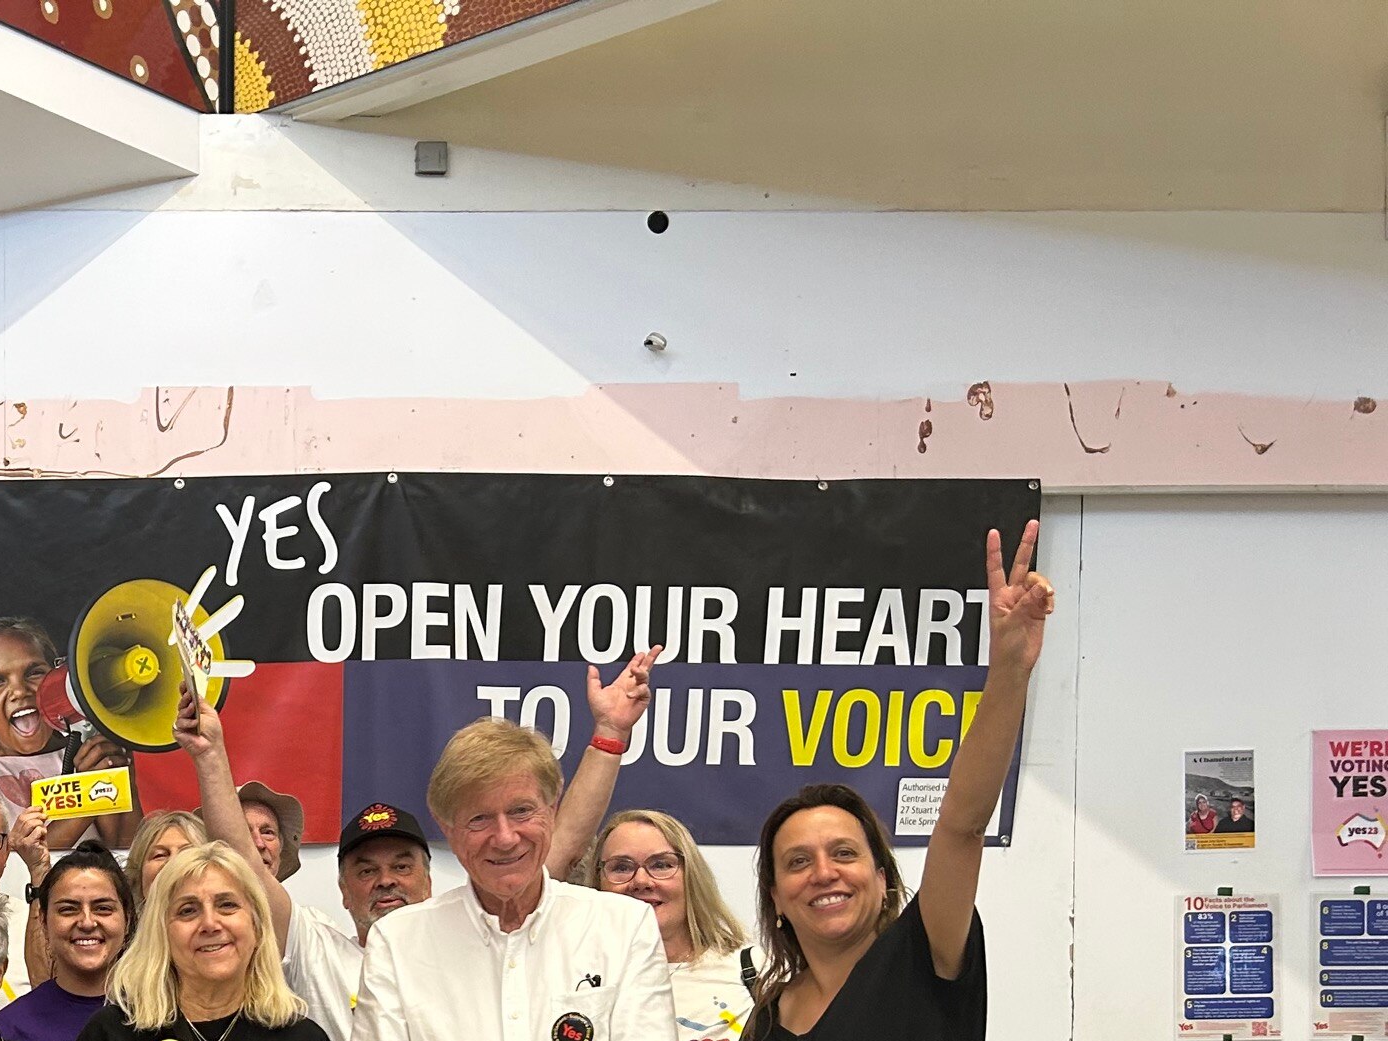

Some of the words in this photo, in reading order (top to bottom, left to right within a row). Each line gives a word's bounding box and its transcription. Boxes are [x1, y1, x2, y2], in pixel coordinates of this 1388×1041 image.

[215, 481, 339, 587] YES
[306, 581, 503, 663] OPEN
[528, 583, 739, 665] YOUR
[1329, 740, 1388, 757] WE'R
[40, 781, 81, 796] VOTE
[902, 783, 940, 792] Authorised
[942, 783, 948, 792] b
[1329, 775, 1387, 798] YES
[41, 794, 82, 811] YES!
[901, 795, 927, 803] Central
[929, 795, 942, 803] Lan
[363, 812, 390, 823] Yes
[900, 806, 909, 814] 27
[911, 806, 933, 814] Stuart
[899, 817, 916, 826] Alice
[918, 817, 937, 827] Sprin
[1184, 897, 1204, 911] 10
[563, 1023, 583, 1041] Yes
